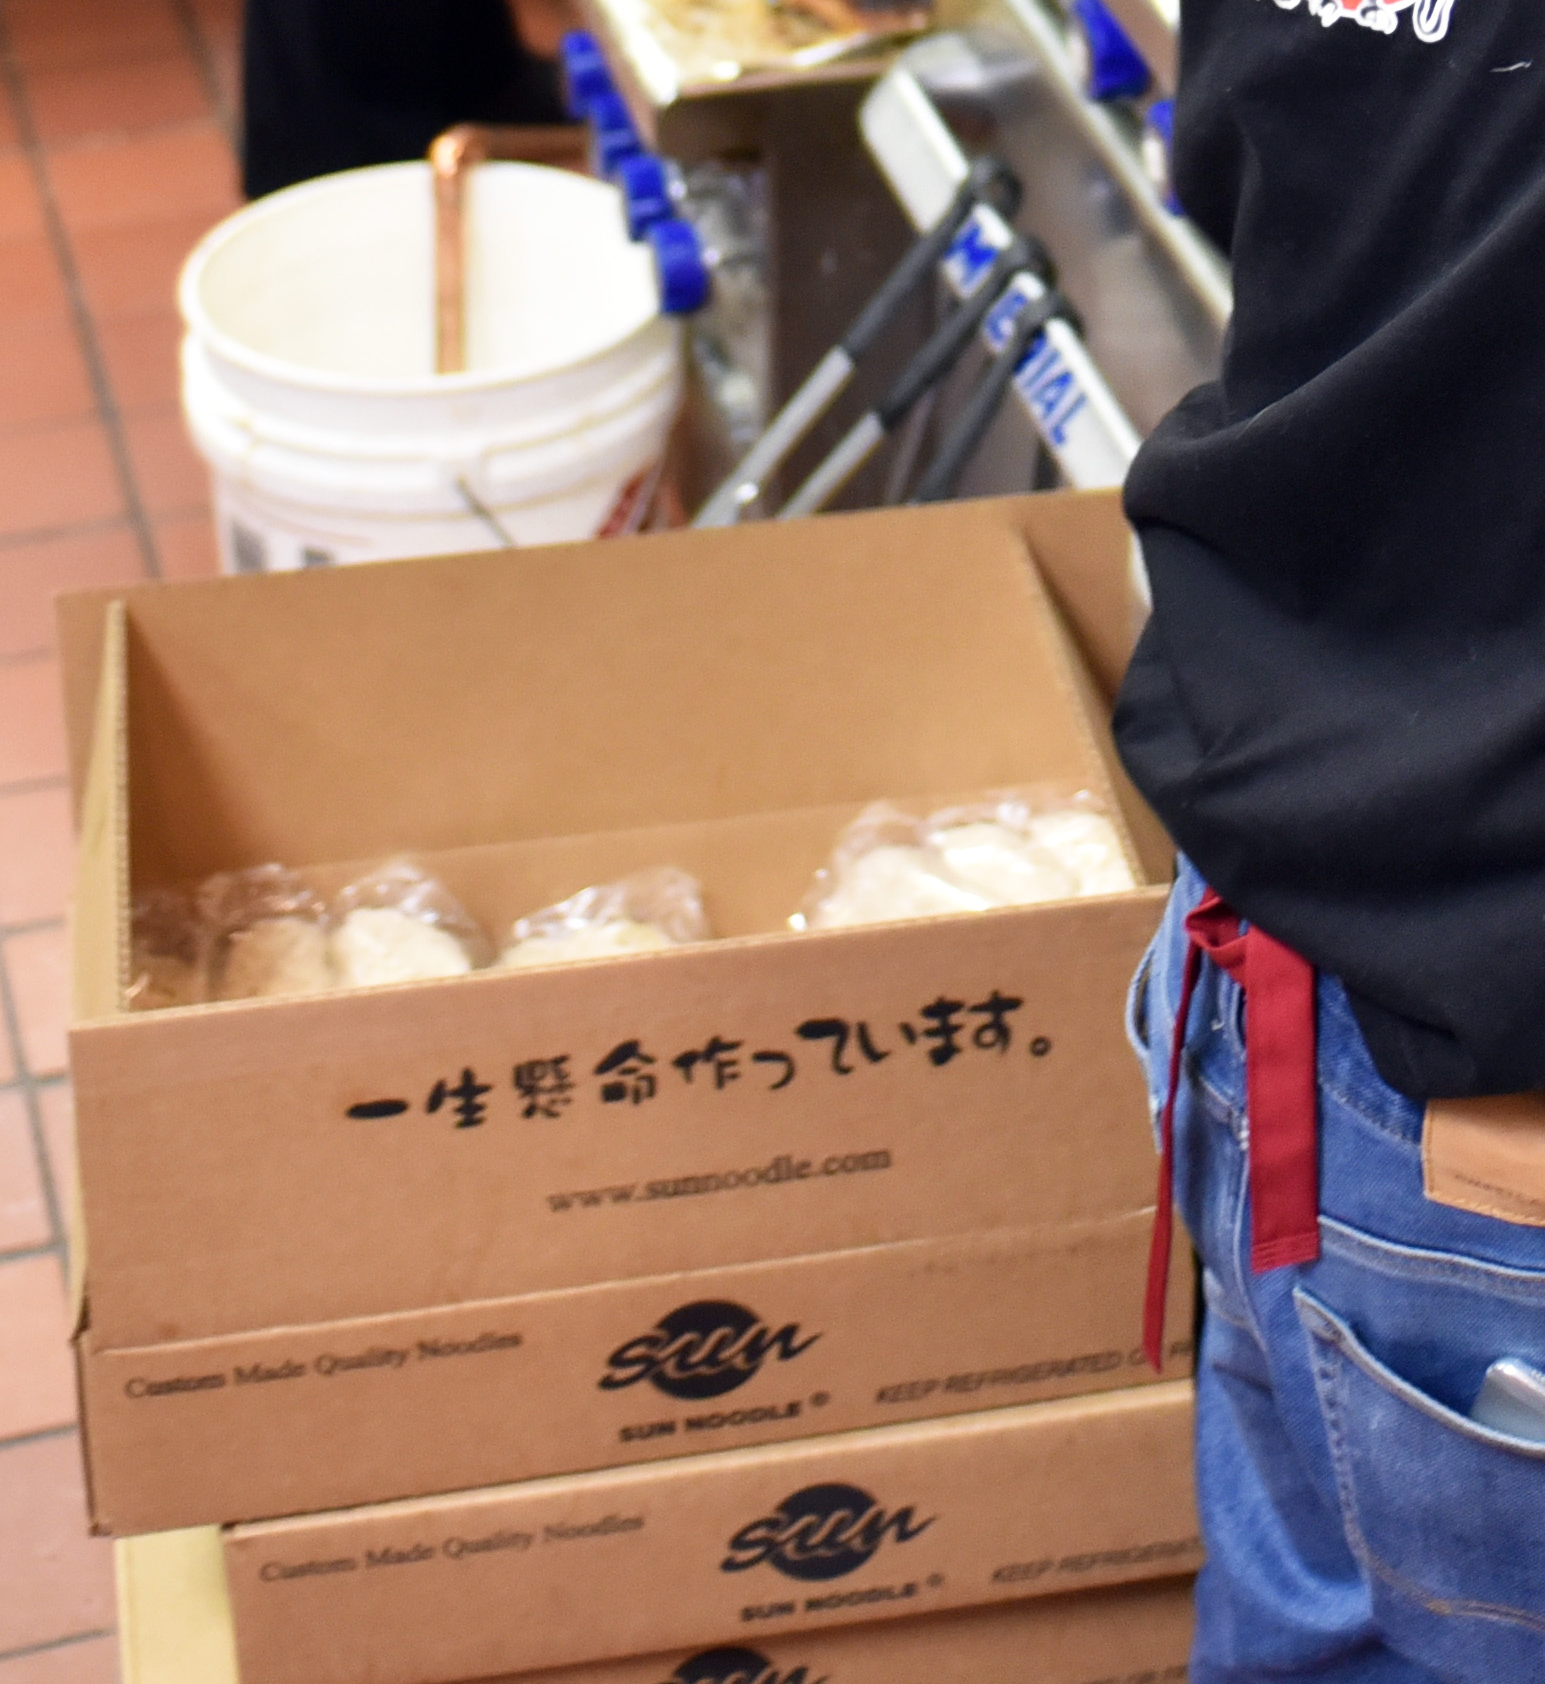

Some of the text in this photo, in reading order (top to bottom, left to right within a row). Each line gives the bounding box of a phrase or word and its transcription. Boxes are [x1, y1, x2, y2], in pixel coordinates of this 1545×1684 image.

[345, 990, 1052, 1128] 一生懸命作っています。
[547, 1146, 893, 1213] www.sunnoodle.com
[124, 1332, 524, 1399] Custom Made Quality Noodles
[875, 1377, 941, 1404] KEEP
[944, 1349, 1125, 1393] REFRIGERATED
[618, 1399, 803, 1443] SUN NOODLE
[259, 1514, 646, 1583] Custom Made Quality Noodles
[740, 1581, 919, 1624] SUN NOODLE
